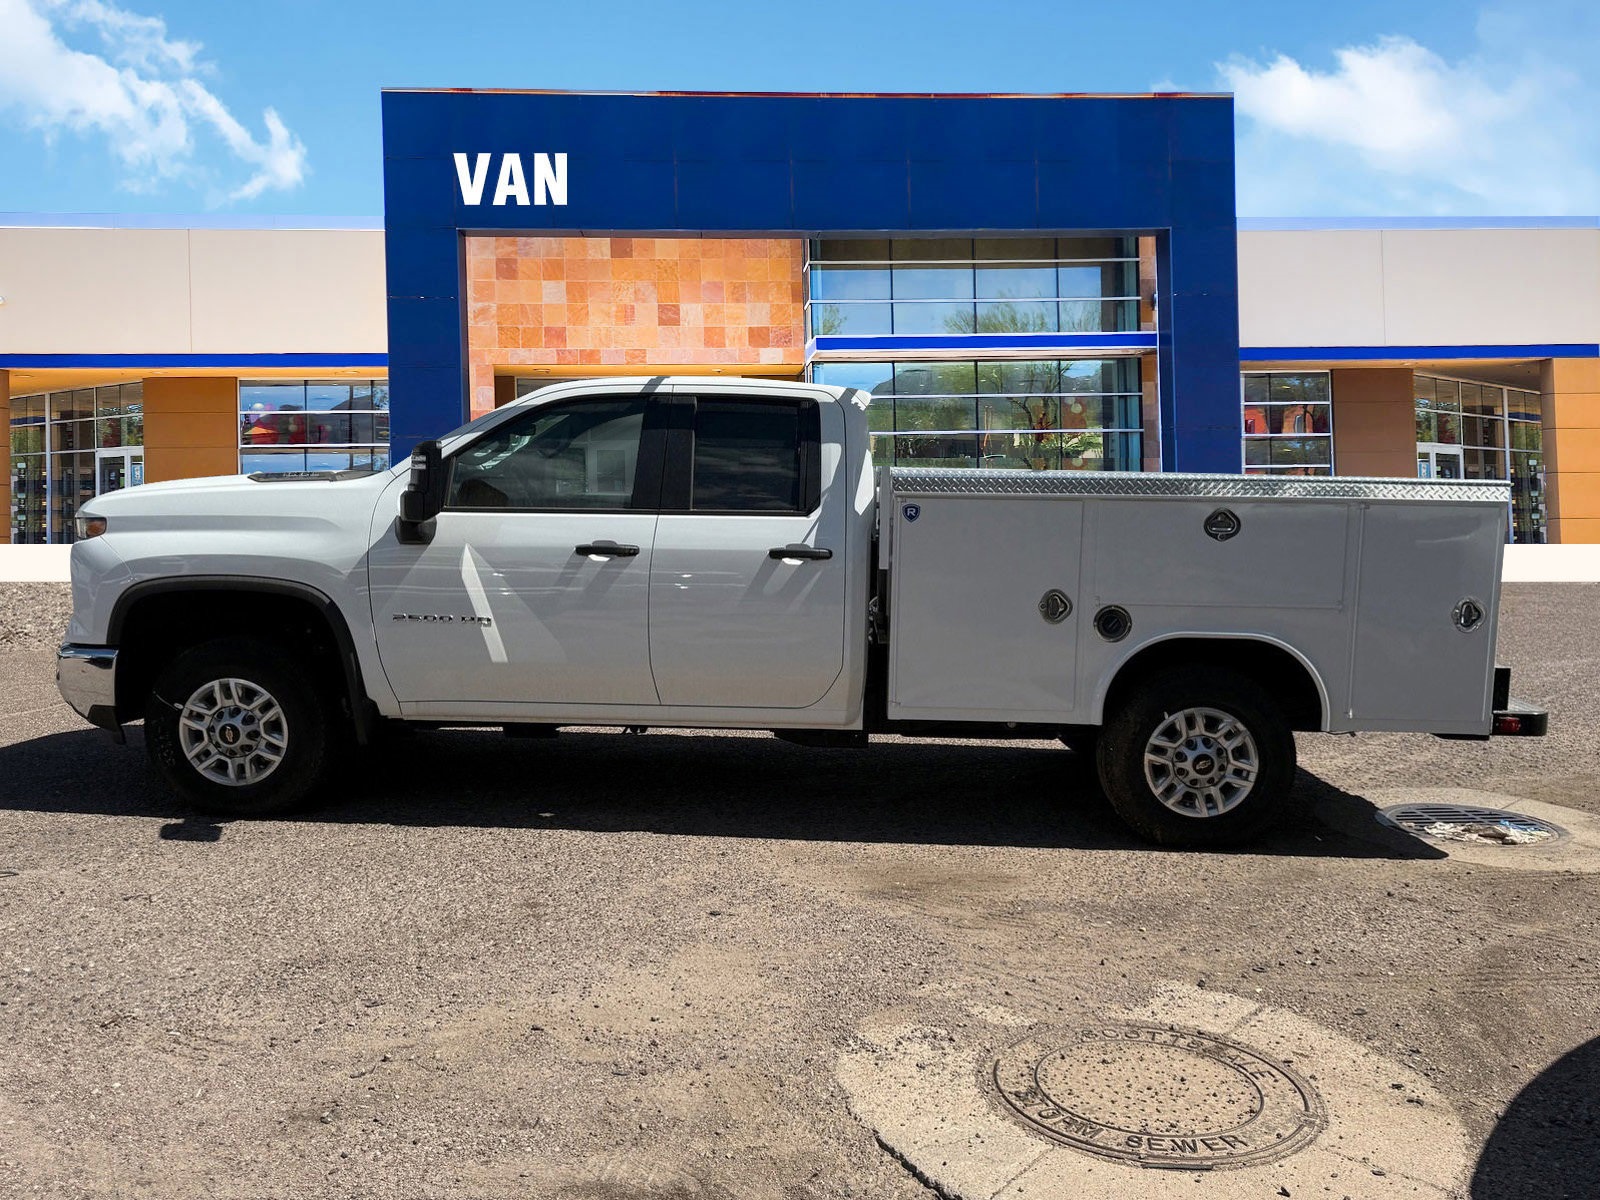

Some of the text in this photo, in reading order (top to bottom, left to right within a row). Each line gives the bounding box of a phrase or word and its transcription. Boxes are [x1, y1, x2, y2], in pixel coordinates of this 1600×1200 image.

[453, 152, 568, 206] VAN
[393, 613, 453, 624] 2500
[1081, 1028, 1276, 1082] SCOTTSALE
[1124, 1134, 1250, 1154] SEWER
